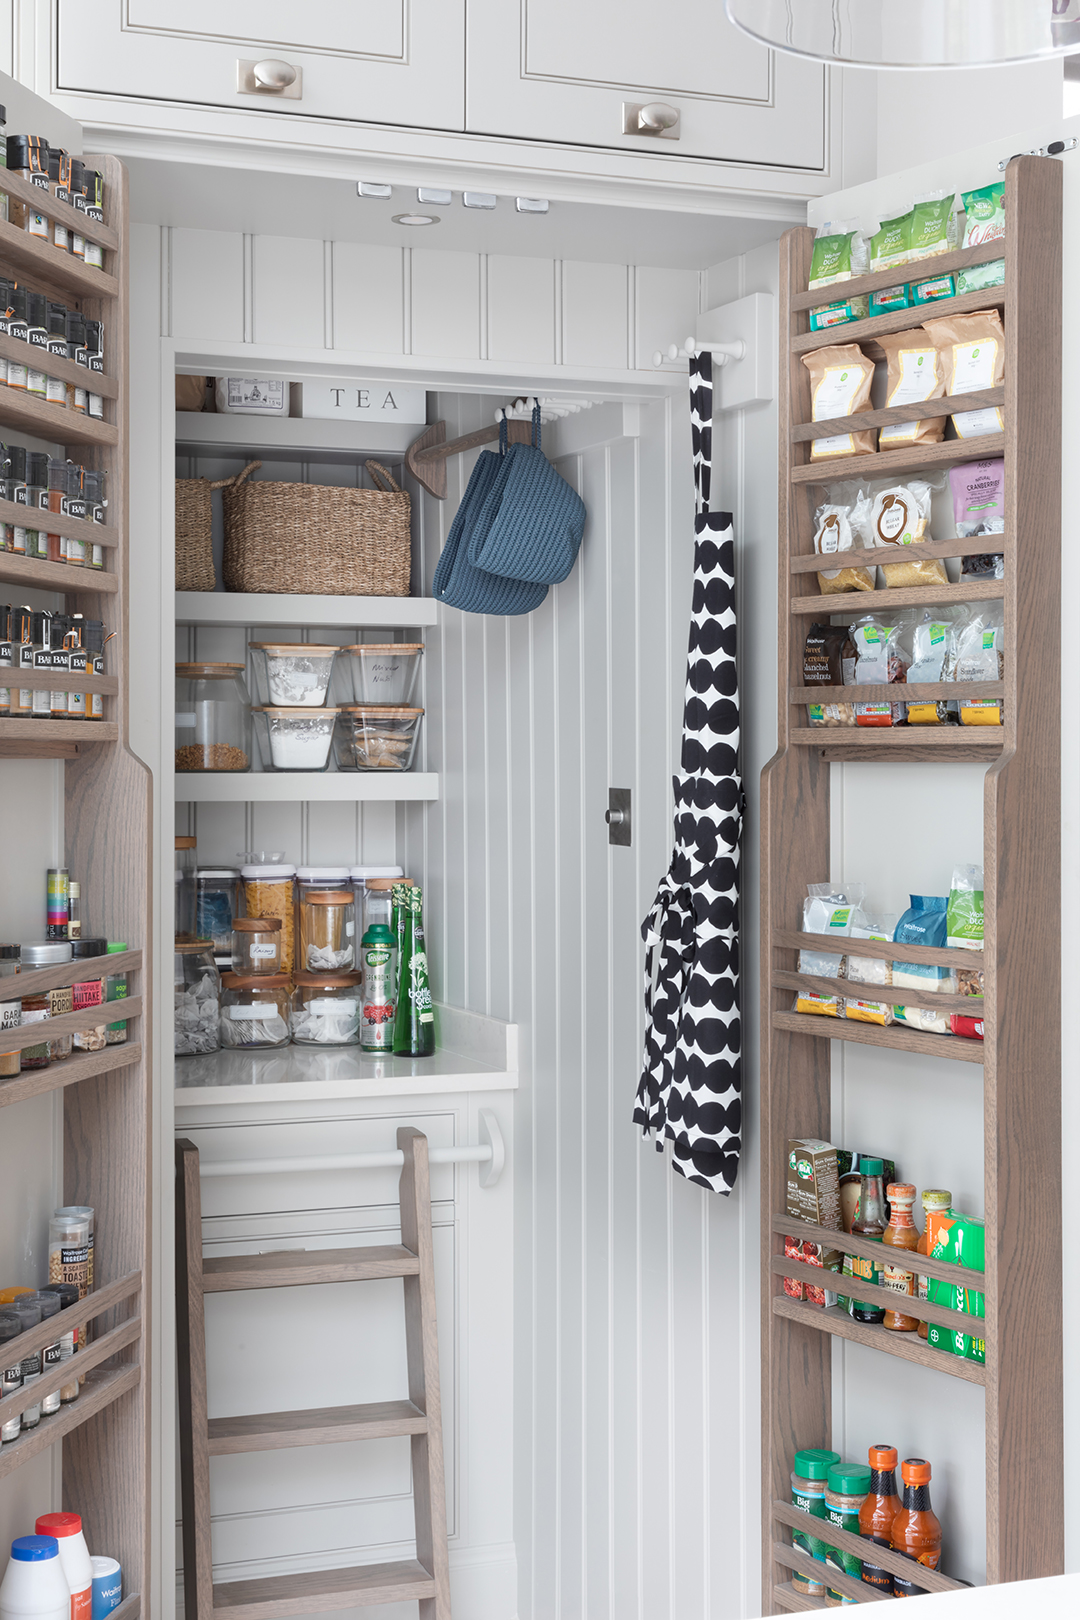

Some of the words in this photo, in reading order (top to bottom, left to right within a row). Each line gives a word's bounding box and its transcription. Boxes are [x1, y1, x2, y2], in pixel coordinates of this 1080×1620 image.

[330, 388, 399, 410] TEA
[966, 480, 1000, 491] CRANBERRIES
[903, 923, 926, 933] Waitrose
[796, 1496, 810, 1509] Big
[830, 1511, 843, 1525] Big
